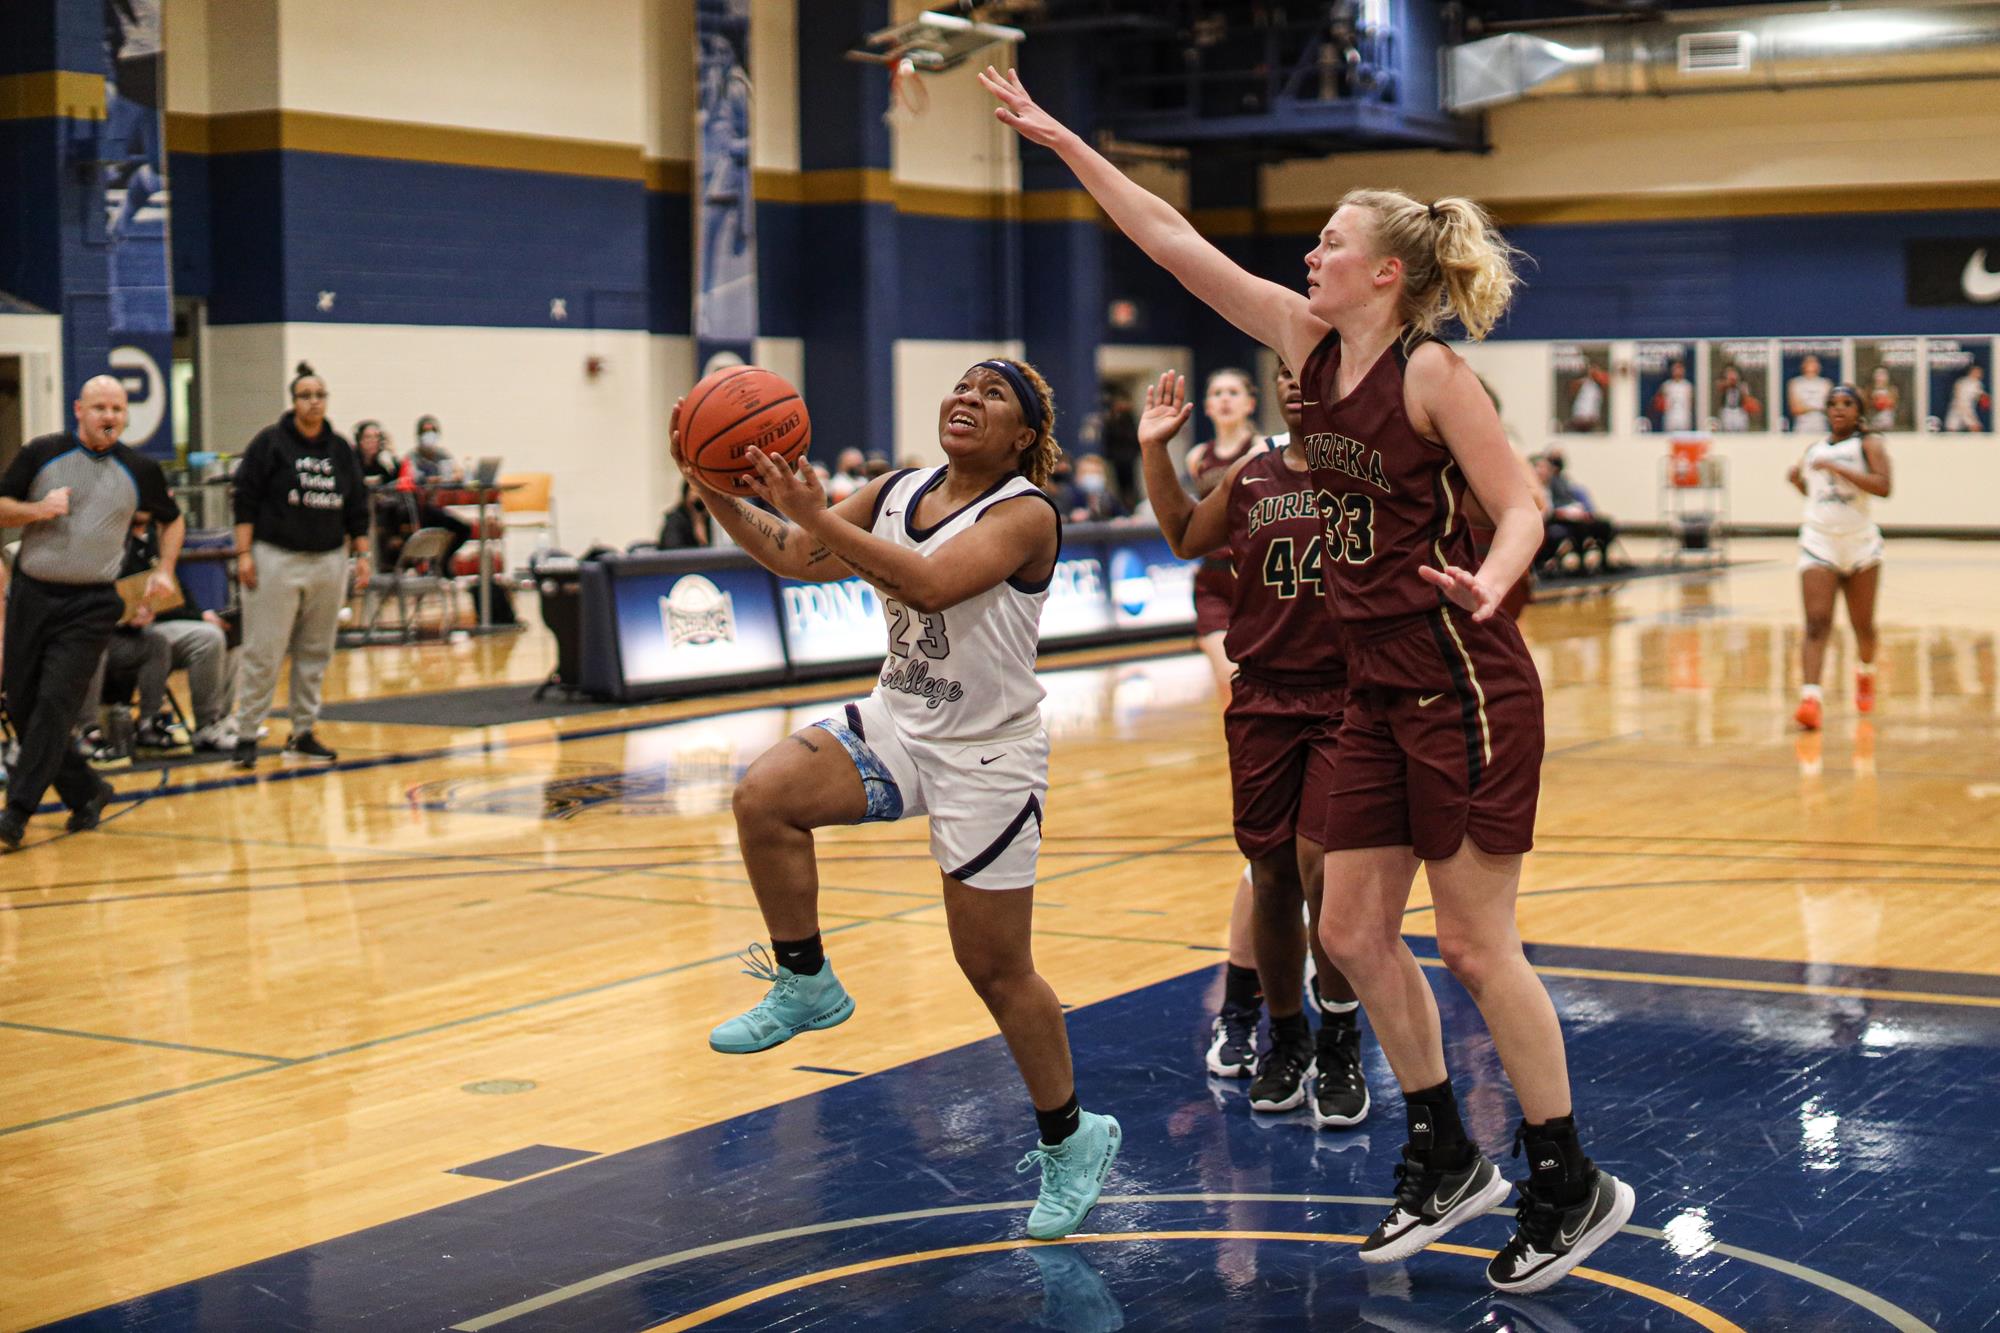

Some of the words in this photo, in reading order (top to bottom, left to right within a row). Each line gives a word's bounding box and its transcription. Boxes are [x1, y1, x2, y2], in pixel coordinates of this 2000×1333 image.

[729, 412, 801, 460] EVOLUTON
[1304, 432, 1391, 493] UREKA
[1248, 489, 1320, 539] EURE
[1316, 488, 1375, 565] 33
[1263, 535, 1325, 600] 44
[783, 579, 882, 632] PRINC
[886, 598, 950, 660] 23
[880, 656, 964, 709] College
